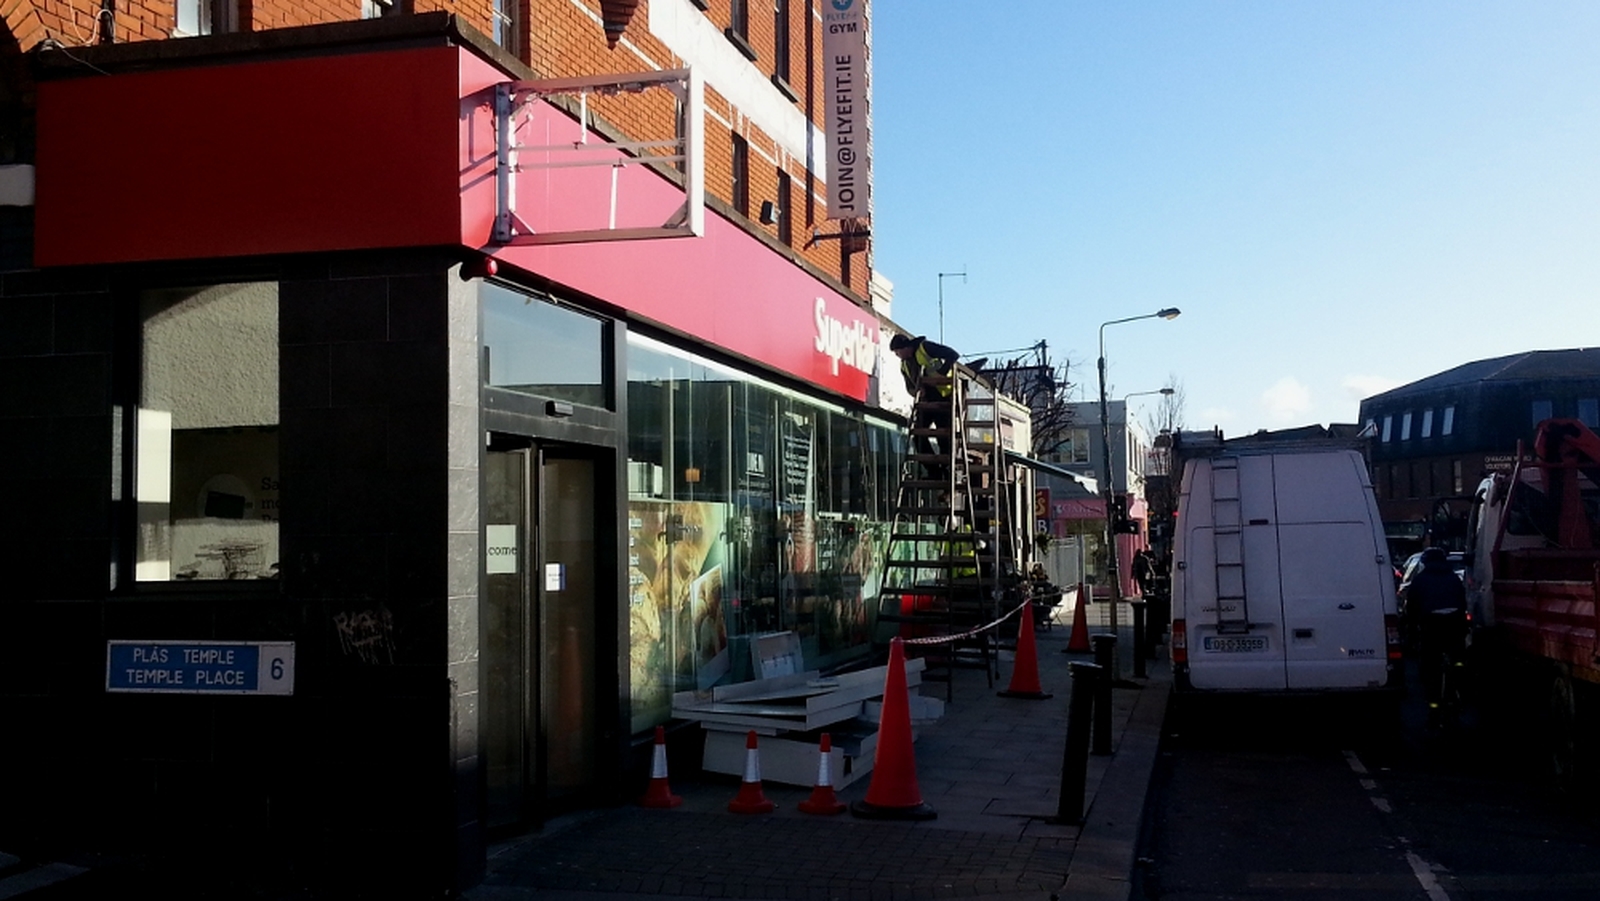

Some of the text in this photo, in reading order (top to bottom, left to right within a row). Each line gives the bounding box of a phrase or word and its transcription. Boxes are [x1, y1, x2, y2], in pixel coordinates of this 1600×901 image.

[829, 22, 857, 34] GYM
[835, 55, 856, 211] JOIN@FLYEFIT.IE
[133, 645, 235, 665] PLÁS TEMPLE
[125, 668, 245, 686] TEMPLE PLACE
[270, 657, 284, 681] 6
